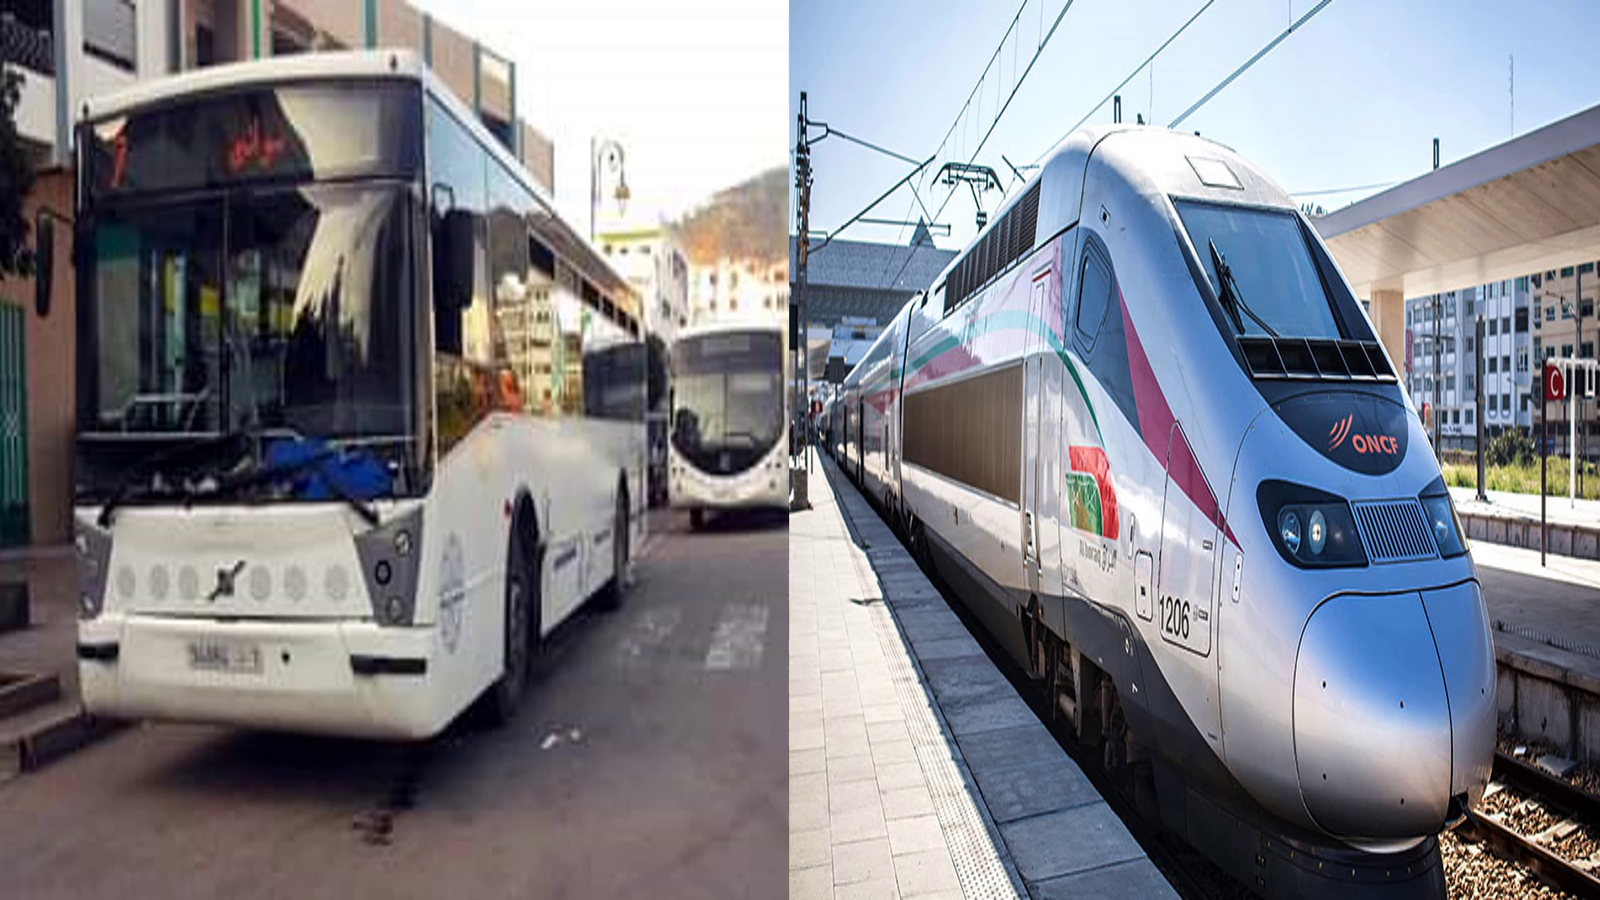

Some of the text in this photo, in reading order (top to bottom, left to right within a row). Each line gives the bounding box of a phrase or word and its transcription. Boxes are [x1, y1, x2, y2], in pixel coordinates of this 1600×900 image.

[1550, 369, 1559, 397] C
[1352, 433, 1398, 455] ONCF
[1160, 594, 1190, 640] 1206
